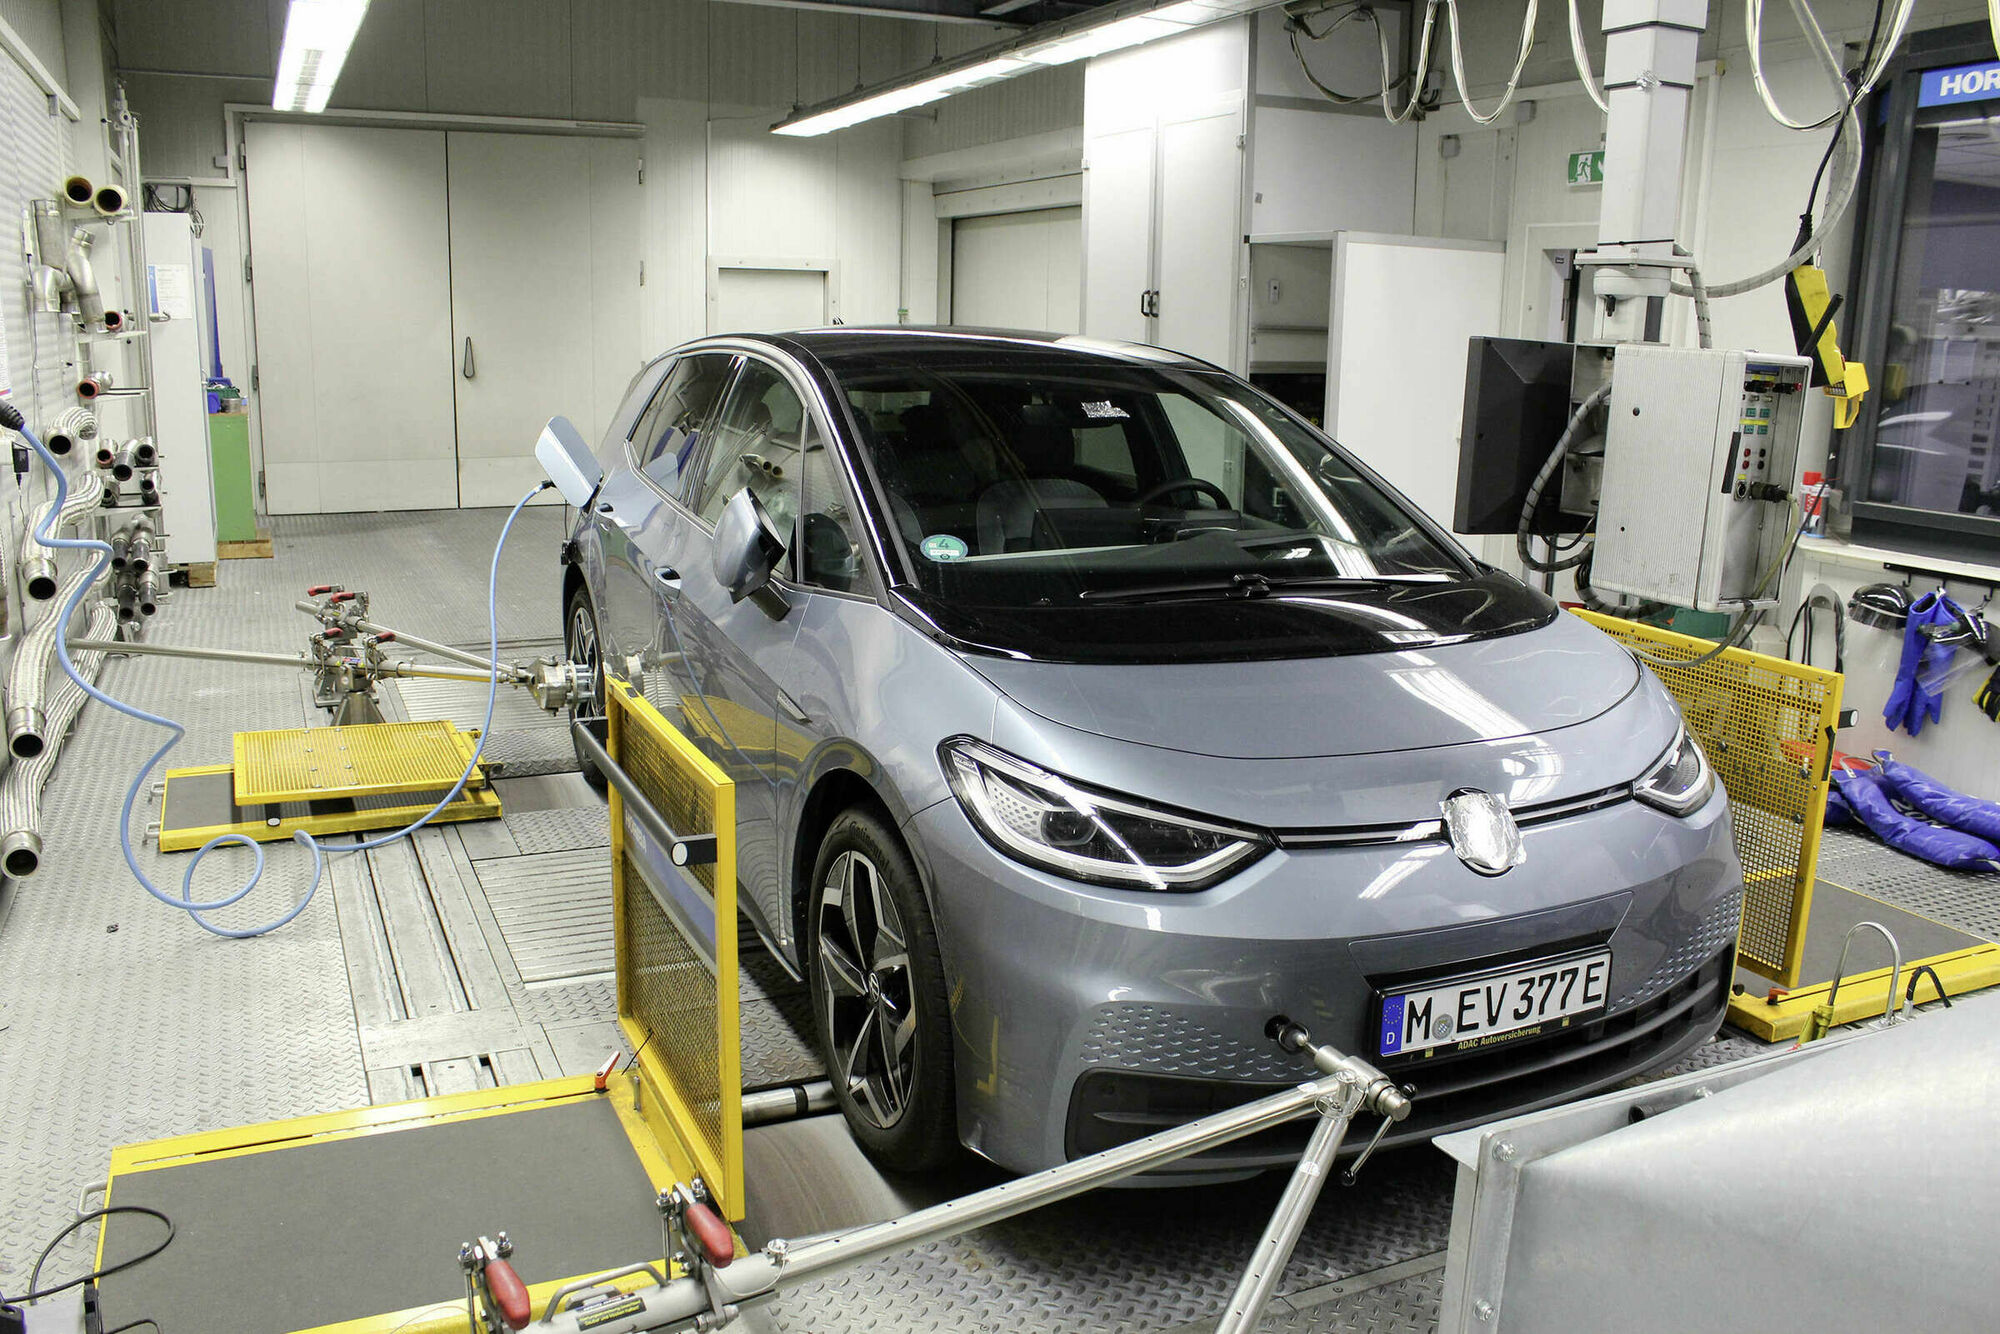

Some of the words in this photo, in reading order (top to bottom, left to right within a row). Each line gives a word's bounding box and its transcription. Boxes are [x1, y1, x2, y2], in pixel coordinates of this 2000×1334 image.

[1940, 68, 2000, 96] HOR
[938, 538, 949, 549] 4
[1406, 997, 1432, 1044] M
[1456, 982, 1508, 1033] EV
[1513, 961, 1605, 1021] 377E
[1386, 1032, 1395, 1045] D
[1457, 1038, 1479, 1050] ADAC
[1480, 1026, 1542, 1046] Autoversicherung
